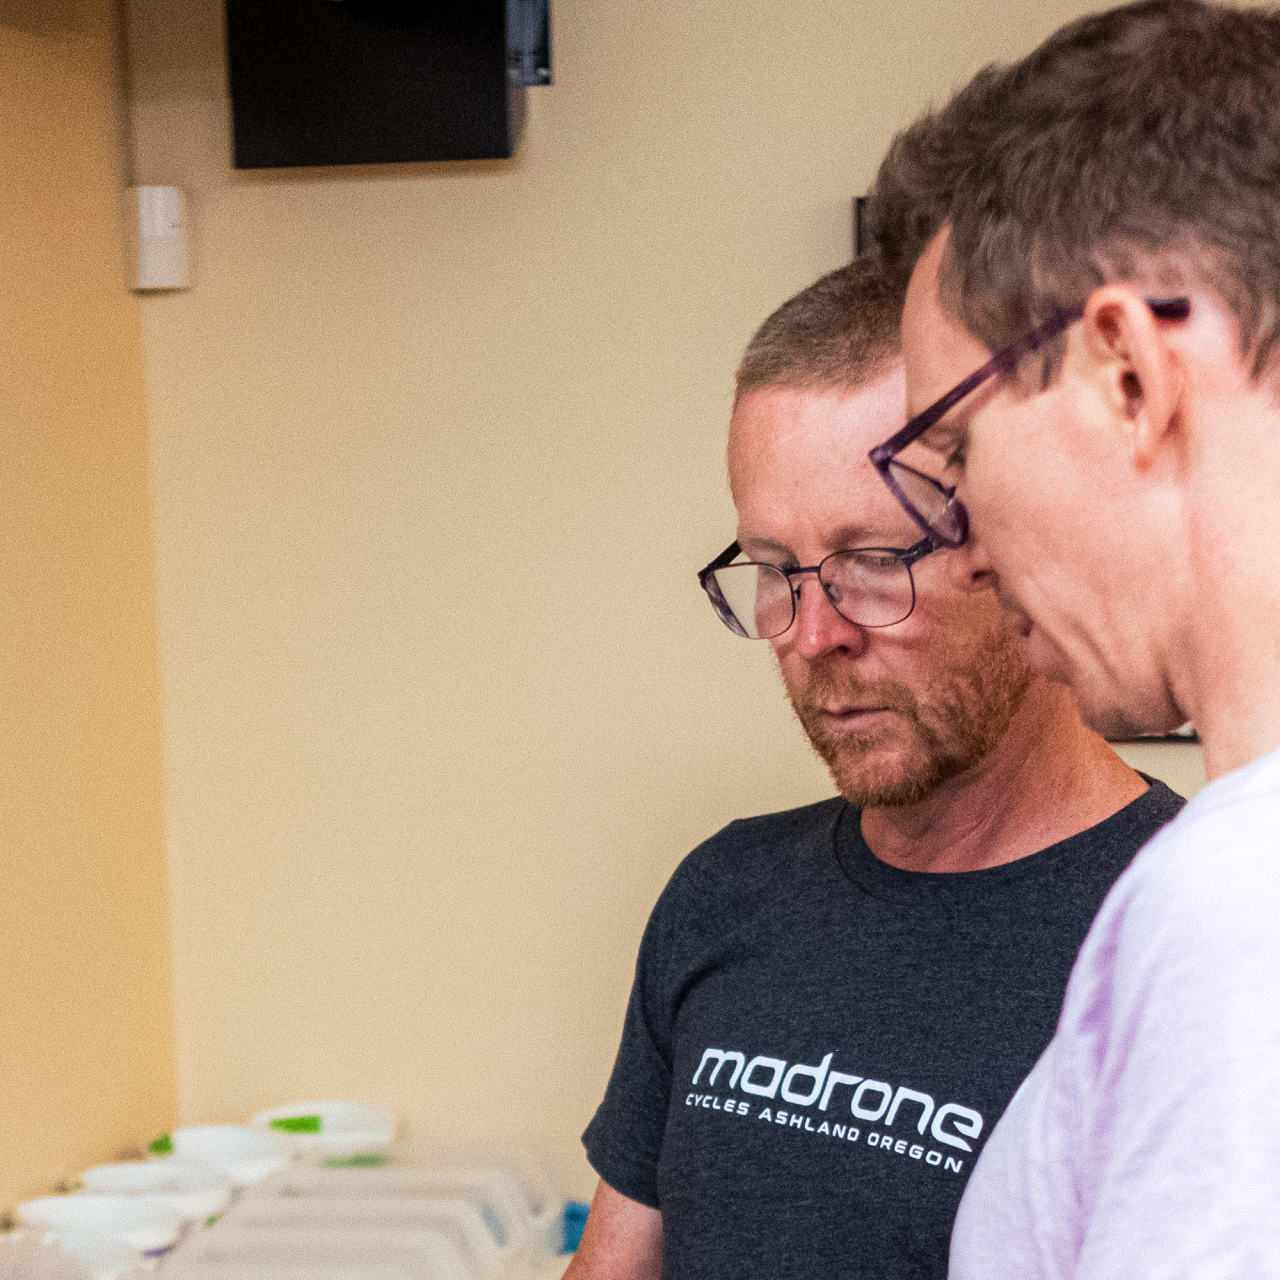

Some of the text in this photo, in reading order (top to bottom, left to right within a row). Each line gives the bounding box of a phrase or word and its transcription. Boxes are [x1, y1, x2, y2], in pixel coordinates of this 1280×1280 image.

[685, 1093, 964, 1174] CYCLES ASHLAND OREGON
[691, 1047, 984, 1153] madrone
